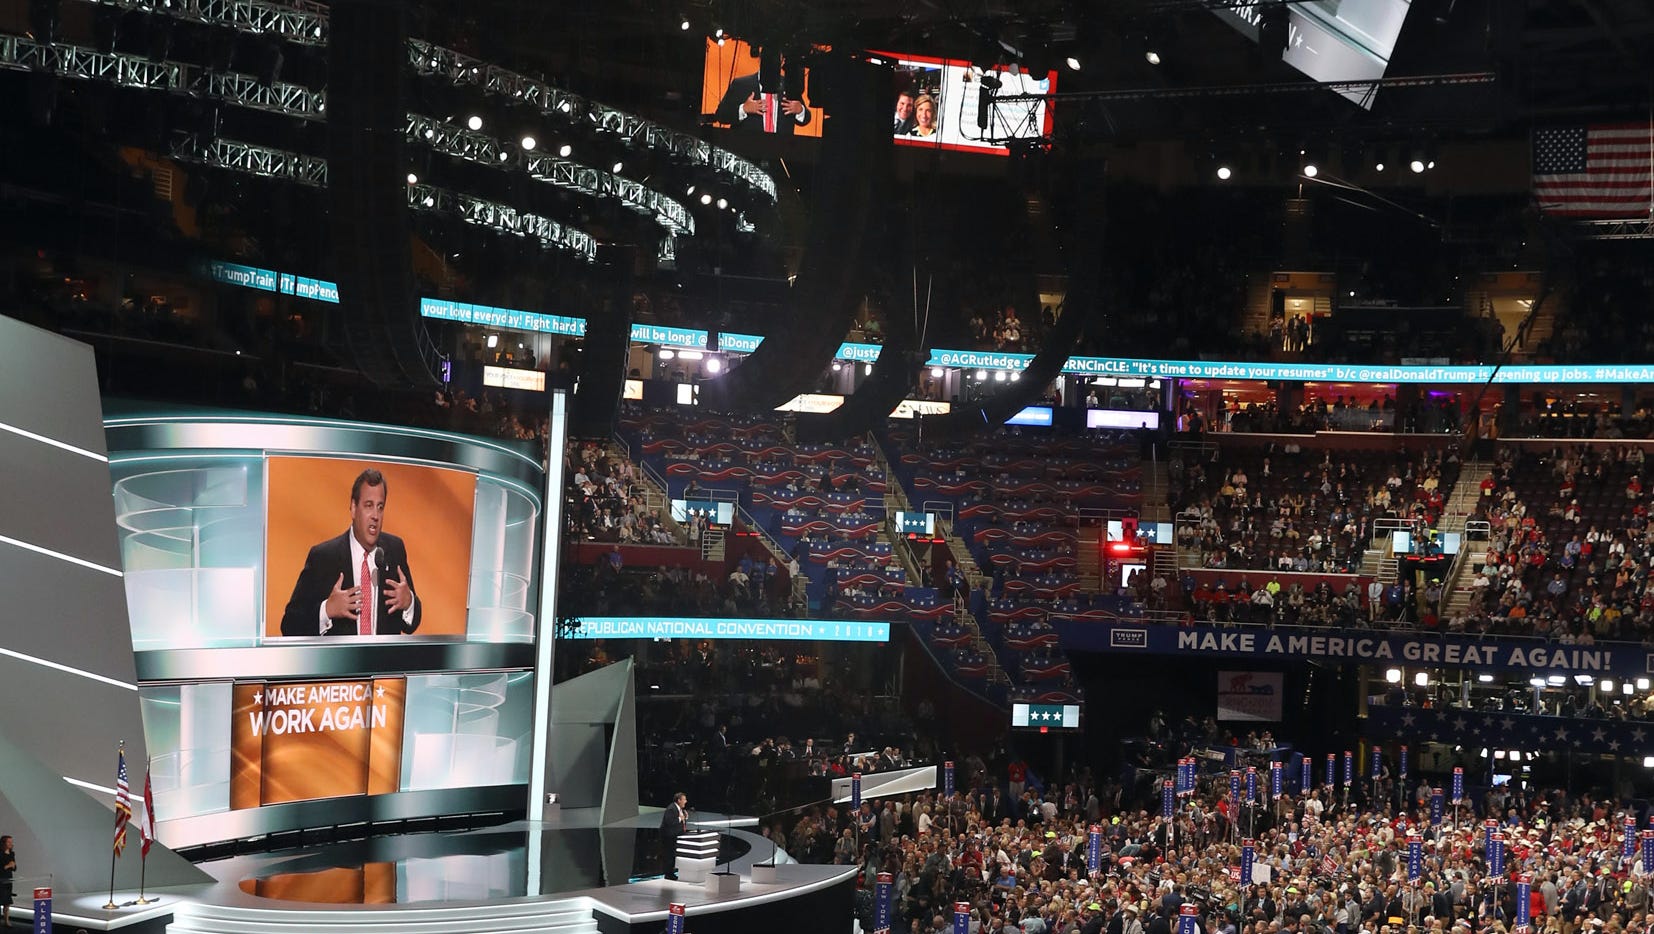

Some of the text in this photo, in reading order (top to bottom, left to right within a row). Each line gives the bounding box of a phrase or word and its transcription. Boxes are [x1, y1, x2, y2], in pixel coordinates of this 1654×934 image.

[423, 304, 446, 315] your
[449, 303, 471, 318] love
[474, 310, 522, 326] everyday!
[525, 316, 550, 330] Fight
[553, 319, 576, 332] hard
[652, 328, 666, 341] be
[668, 331, 695, 346] long!
[941, 354, 1020, 369] @AGRutledge
[1132, 361, 1157, 373] "It's
[1159, 362, 1186, 374] time
[1189, 363, 1201, 375] to
[1204, 364, 1245, 377] update
[1249, 368, 1275, 378] your
[1278, 367, 1333, 378] resumes"
[1337, 368, 1356, 379] b/c
[1359, 368, 1475, 382] @realDonaldTrump
[1479, 368, 1488, 379] is
[1544, 370, 1557, 382] up
[1561, 368, 1590, 382] jobs.
[575, 621, 645, 634] EPUBLICAN
[647, 621, 713, 635] NATIONAL
[717, 622, 813, 636] CONVENTION
[1178, 631, 1611, 670] MAKE AMERICA GREAT AGAIN!
[265, 684, 373, 706] MAKE AMERICA
[249, 704, 386, 737] WORK AGAIN
[1411, 844, 1419, 875] NEVADA
